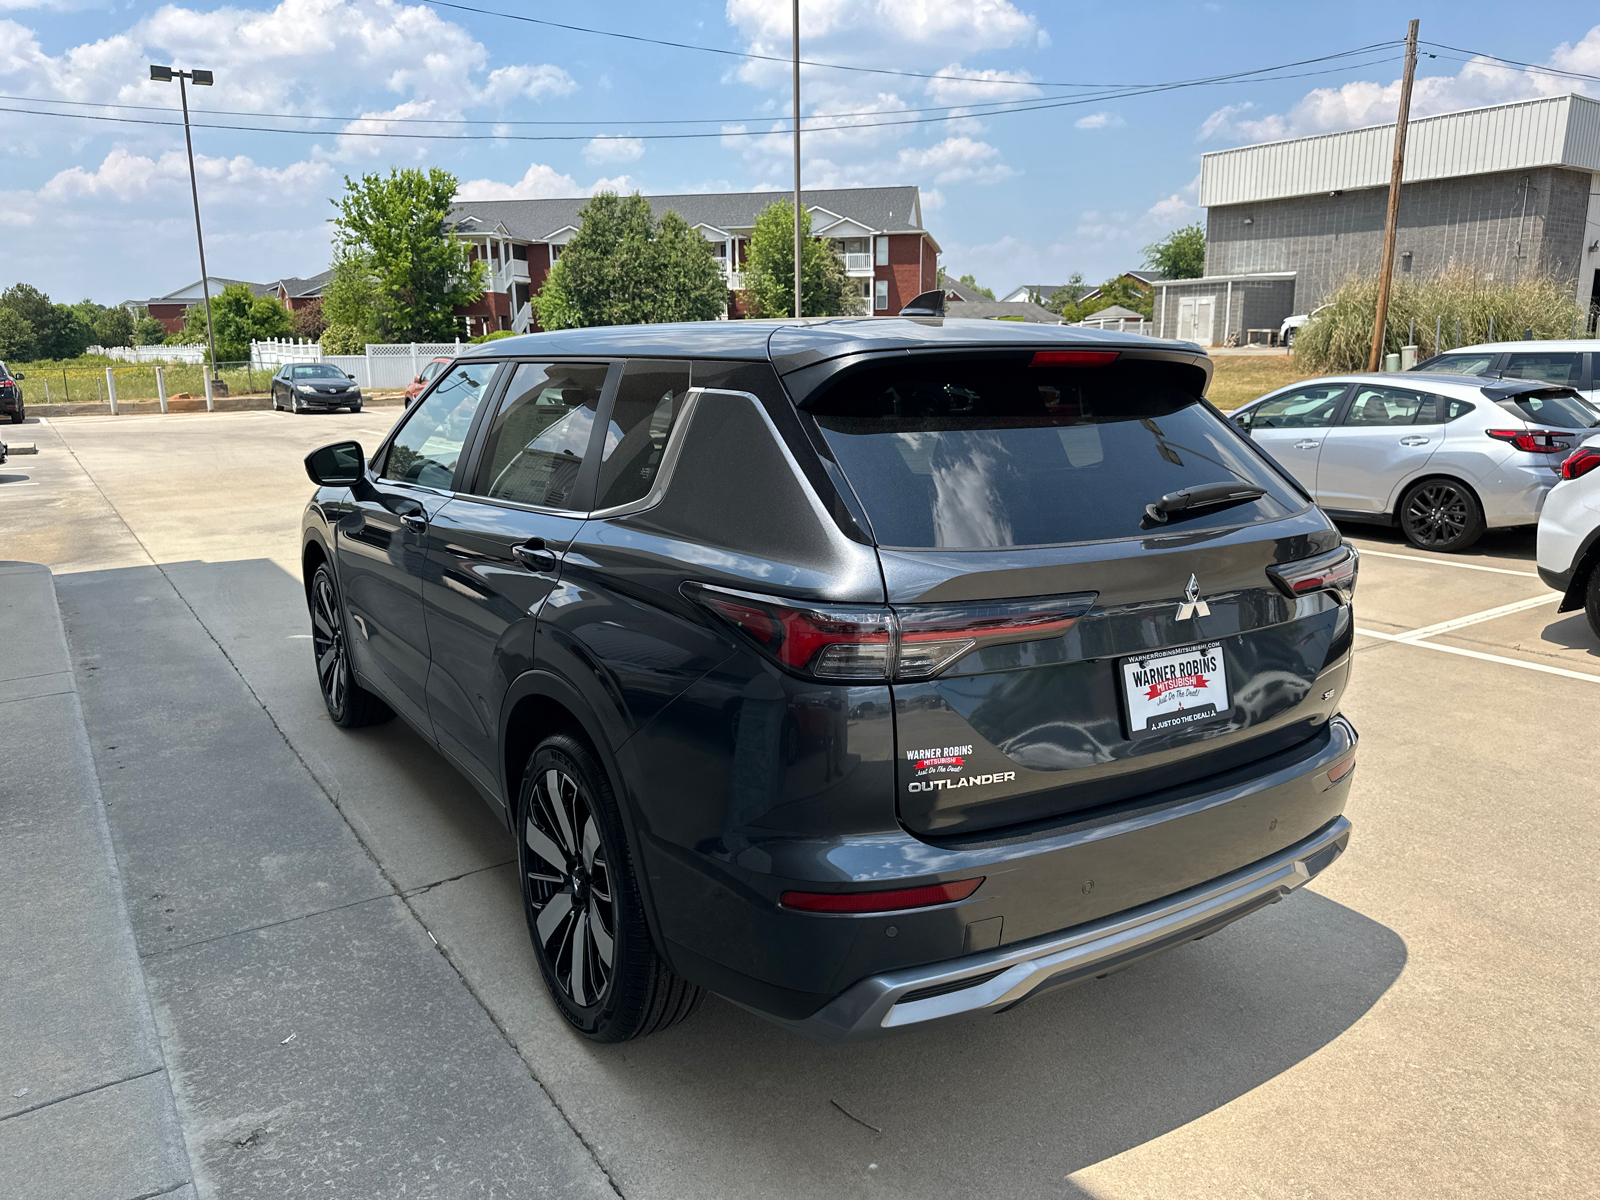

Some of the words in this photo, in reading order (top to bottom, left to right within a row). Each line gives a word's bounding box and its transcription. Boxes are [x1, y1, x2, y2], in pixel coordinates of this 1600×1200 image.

[1132, 664, 1176, 688] WARNER
[1178, 656, 1217, 678] ROBINS
[1156, 676, 1197, 693] MITSUBISHI
[1169, 692, 1175, 701] Do
[1176, 690, 1185, 698] The
[1156, 720, 1172, 729] JUST
[1181, 714, 1194, 723] THE
[1194, 710, 1211, 721] DEAL!
[906, 748, 942, 760] WARNER
[943, 744, 973, 757] ROBINS
[923, 757, 957, 766] MITSUBISHI
[928, 766, 936, 774] Do
[936, 765, 946, 773] The
[908, 771, 1016, 793] OUTLANDER
